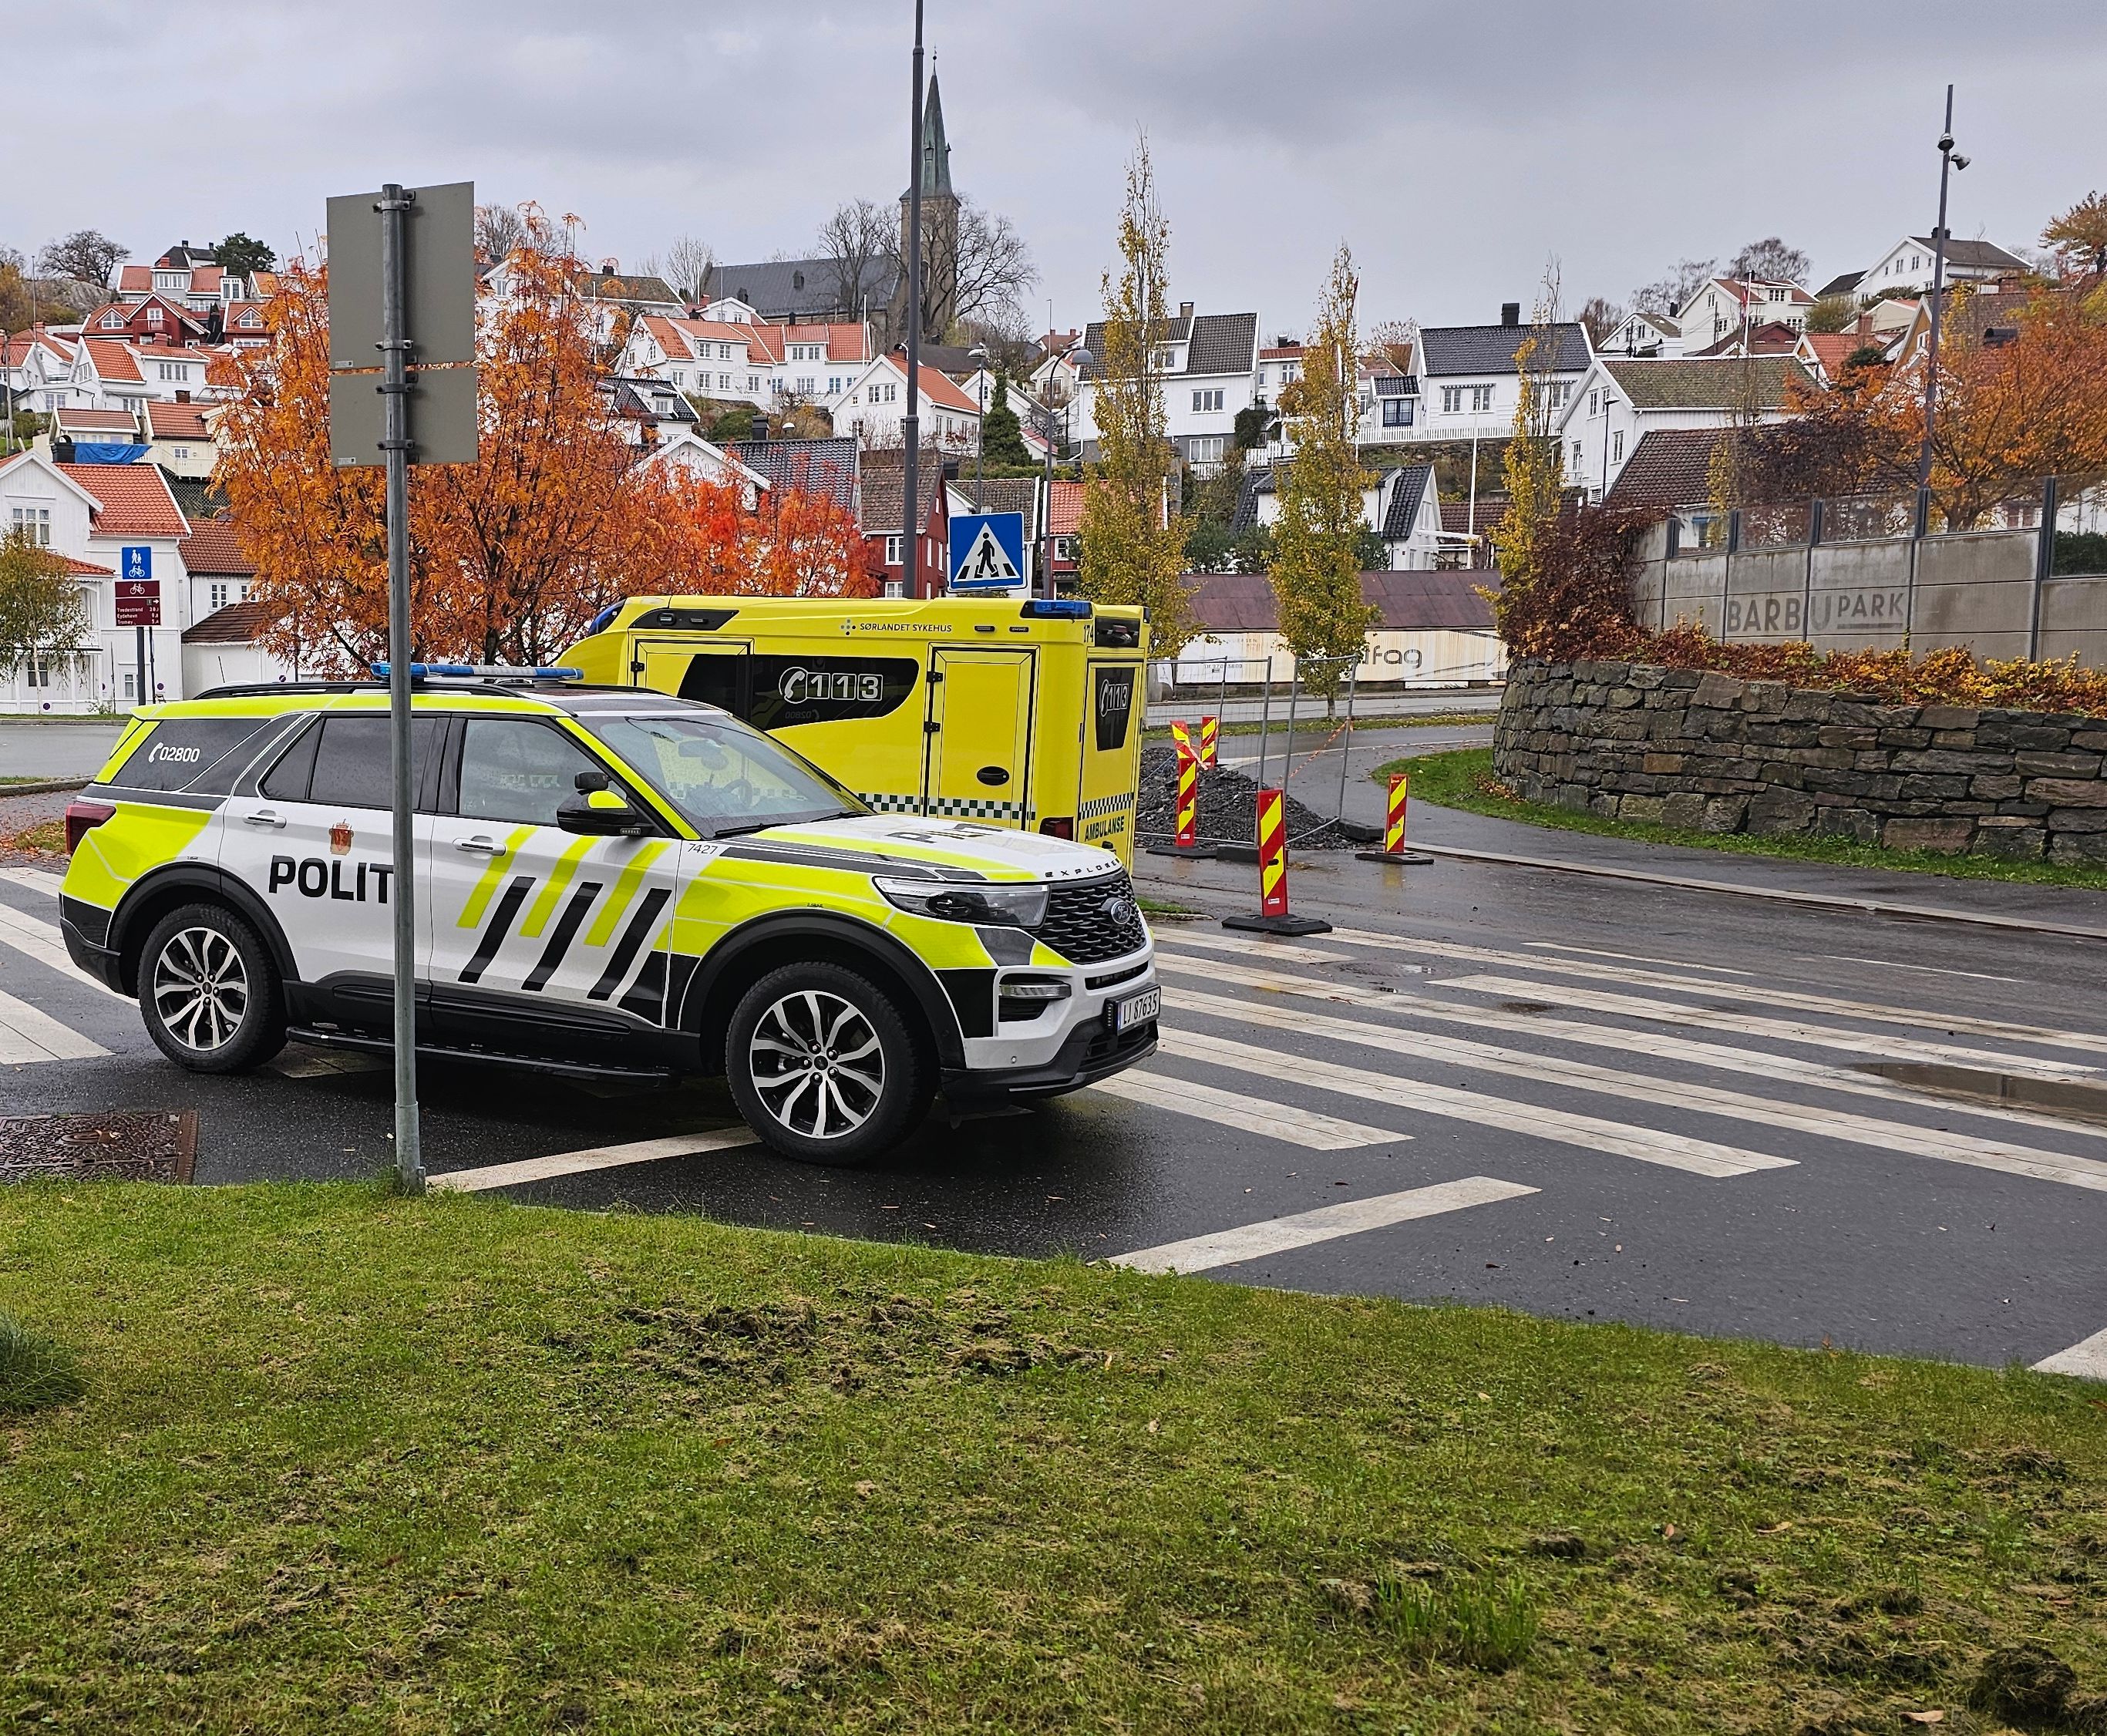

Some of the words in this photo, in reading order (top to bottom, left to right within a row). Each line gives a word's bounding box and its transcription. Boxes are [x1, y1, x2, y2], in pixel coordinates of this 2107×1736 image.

[1726, 597, 1832, 632] BARBU
[1837, 592, 1905, 617] PARK
[860, 623, 910, 631] SØRLANDET
[912, 624, 952, 632] SYKEHUS
[811, 675, 879, 699] 113
[1109, 685, 1127, 708] 113
[160, 746, 200, 762] 02800
[1085, 816, 1125, 842] AMBULANSE
[688, 843, 718, 855] 7427
[269, 855, 395, 903] POLIT
[1123, 1003, 1132, 1024] LJ
[1134, 993, 1157, 1020] 87635
